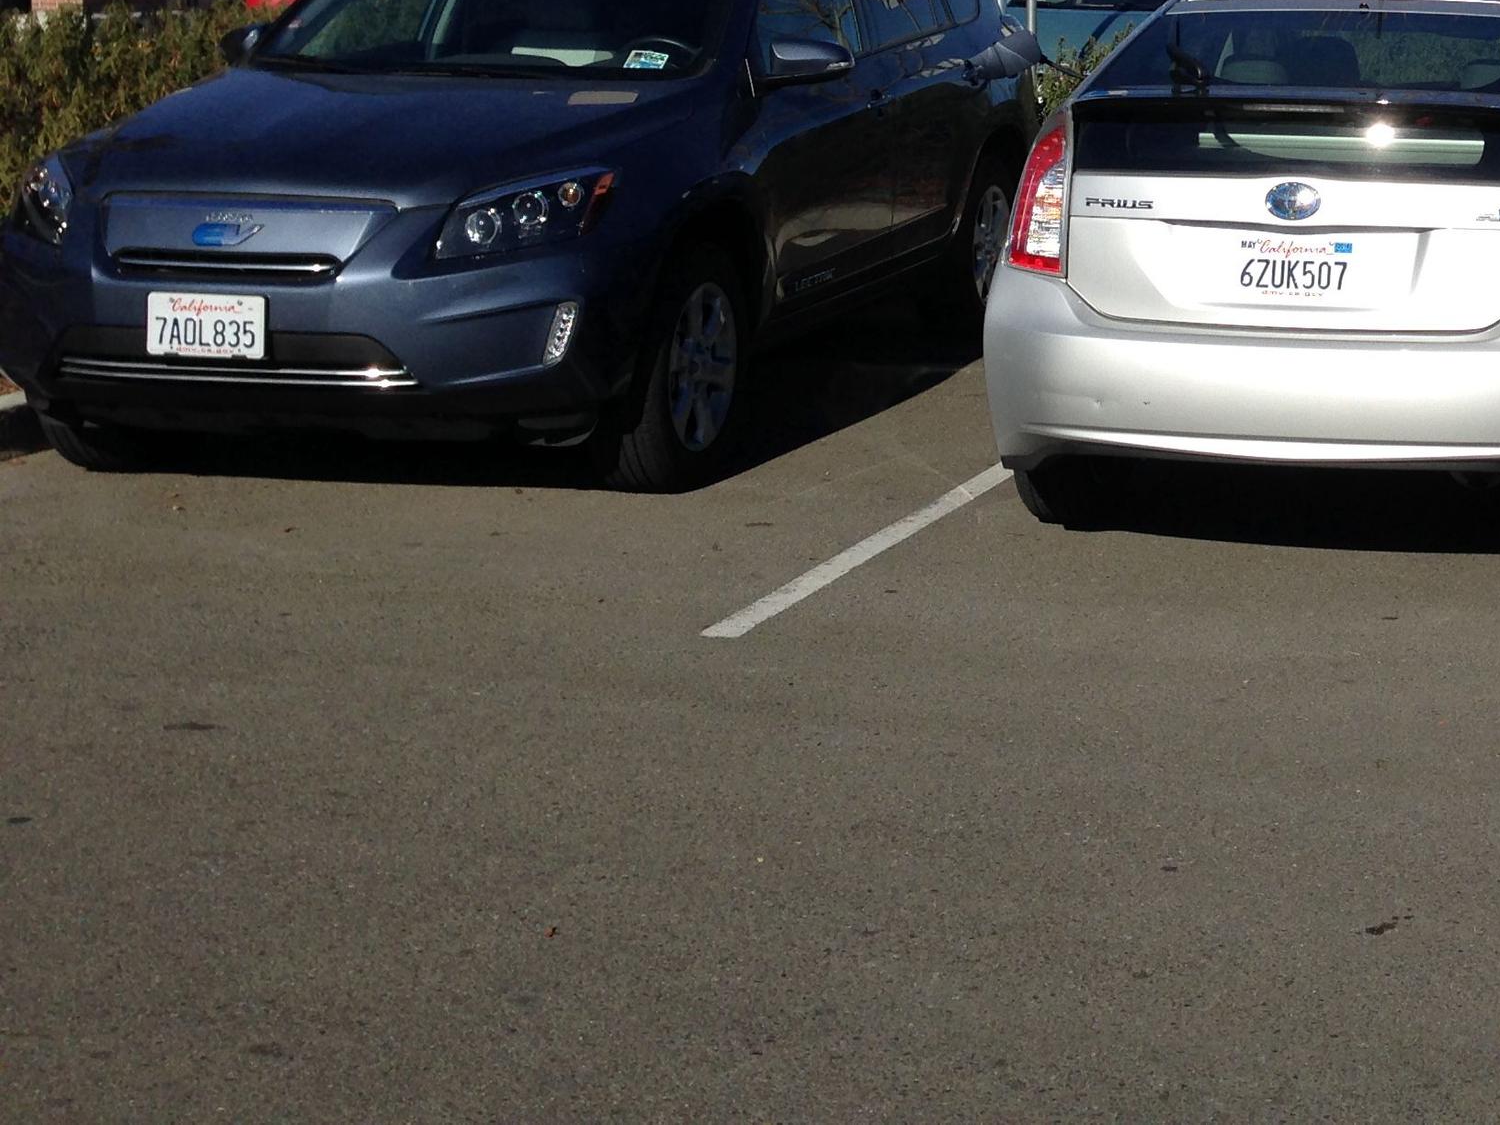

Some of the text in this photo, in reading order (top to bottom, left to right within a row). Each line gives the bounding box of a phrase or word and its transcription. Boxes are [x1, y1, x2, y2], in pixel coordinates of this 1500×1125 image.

[1085, 197, 1154, 209] PRIUS
[1260, 238, 1327, 259] California
[1240, 258, 1348, 290] 6ZUK507
[171, 297, 241, 316] California
